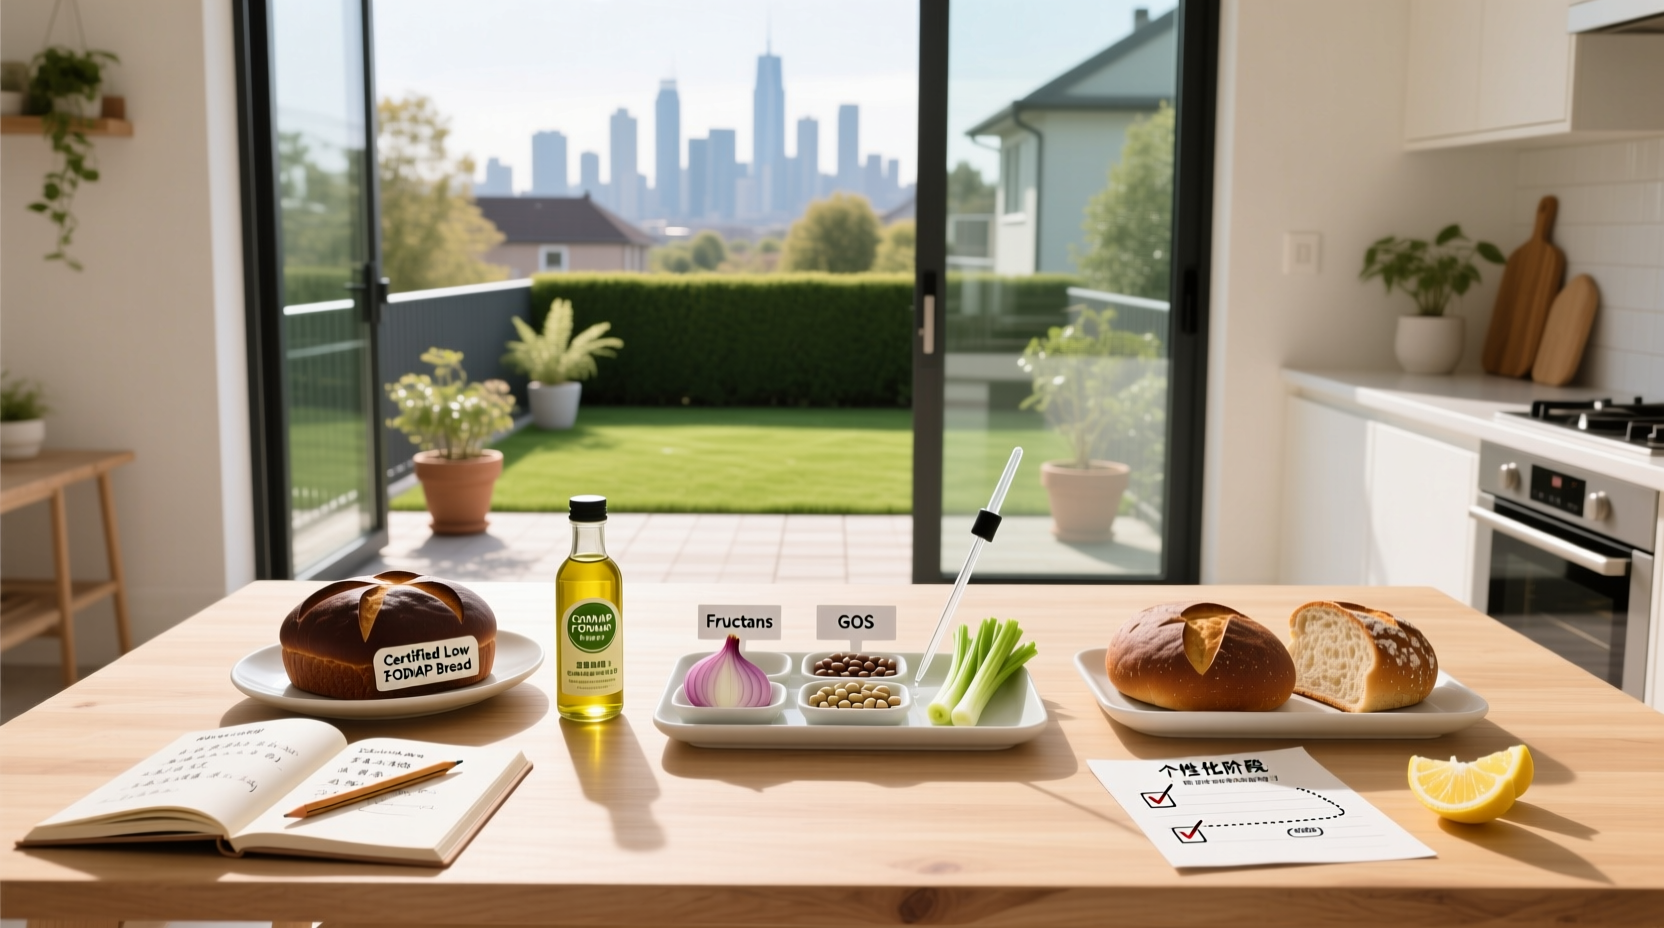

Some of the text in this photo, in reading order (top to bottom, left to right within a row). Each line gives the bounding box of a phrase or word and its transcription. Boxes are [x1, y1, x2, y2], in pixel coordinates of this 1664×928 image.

[706, 614, 773, 629] Fructans
[838, 614, 875, 629] GOS
[384, 645, 470, 666] Certified Low
[436, 657, 472, 675] Bread
[1158, 759, 1269, 778] 个性化阶段
